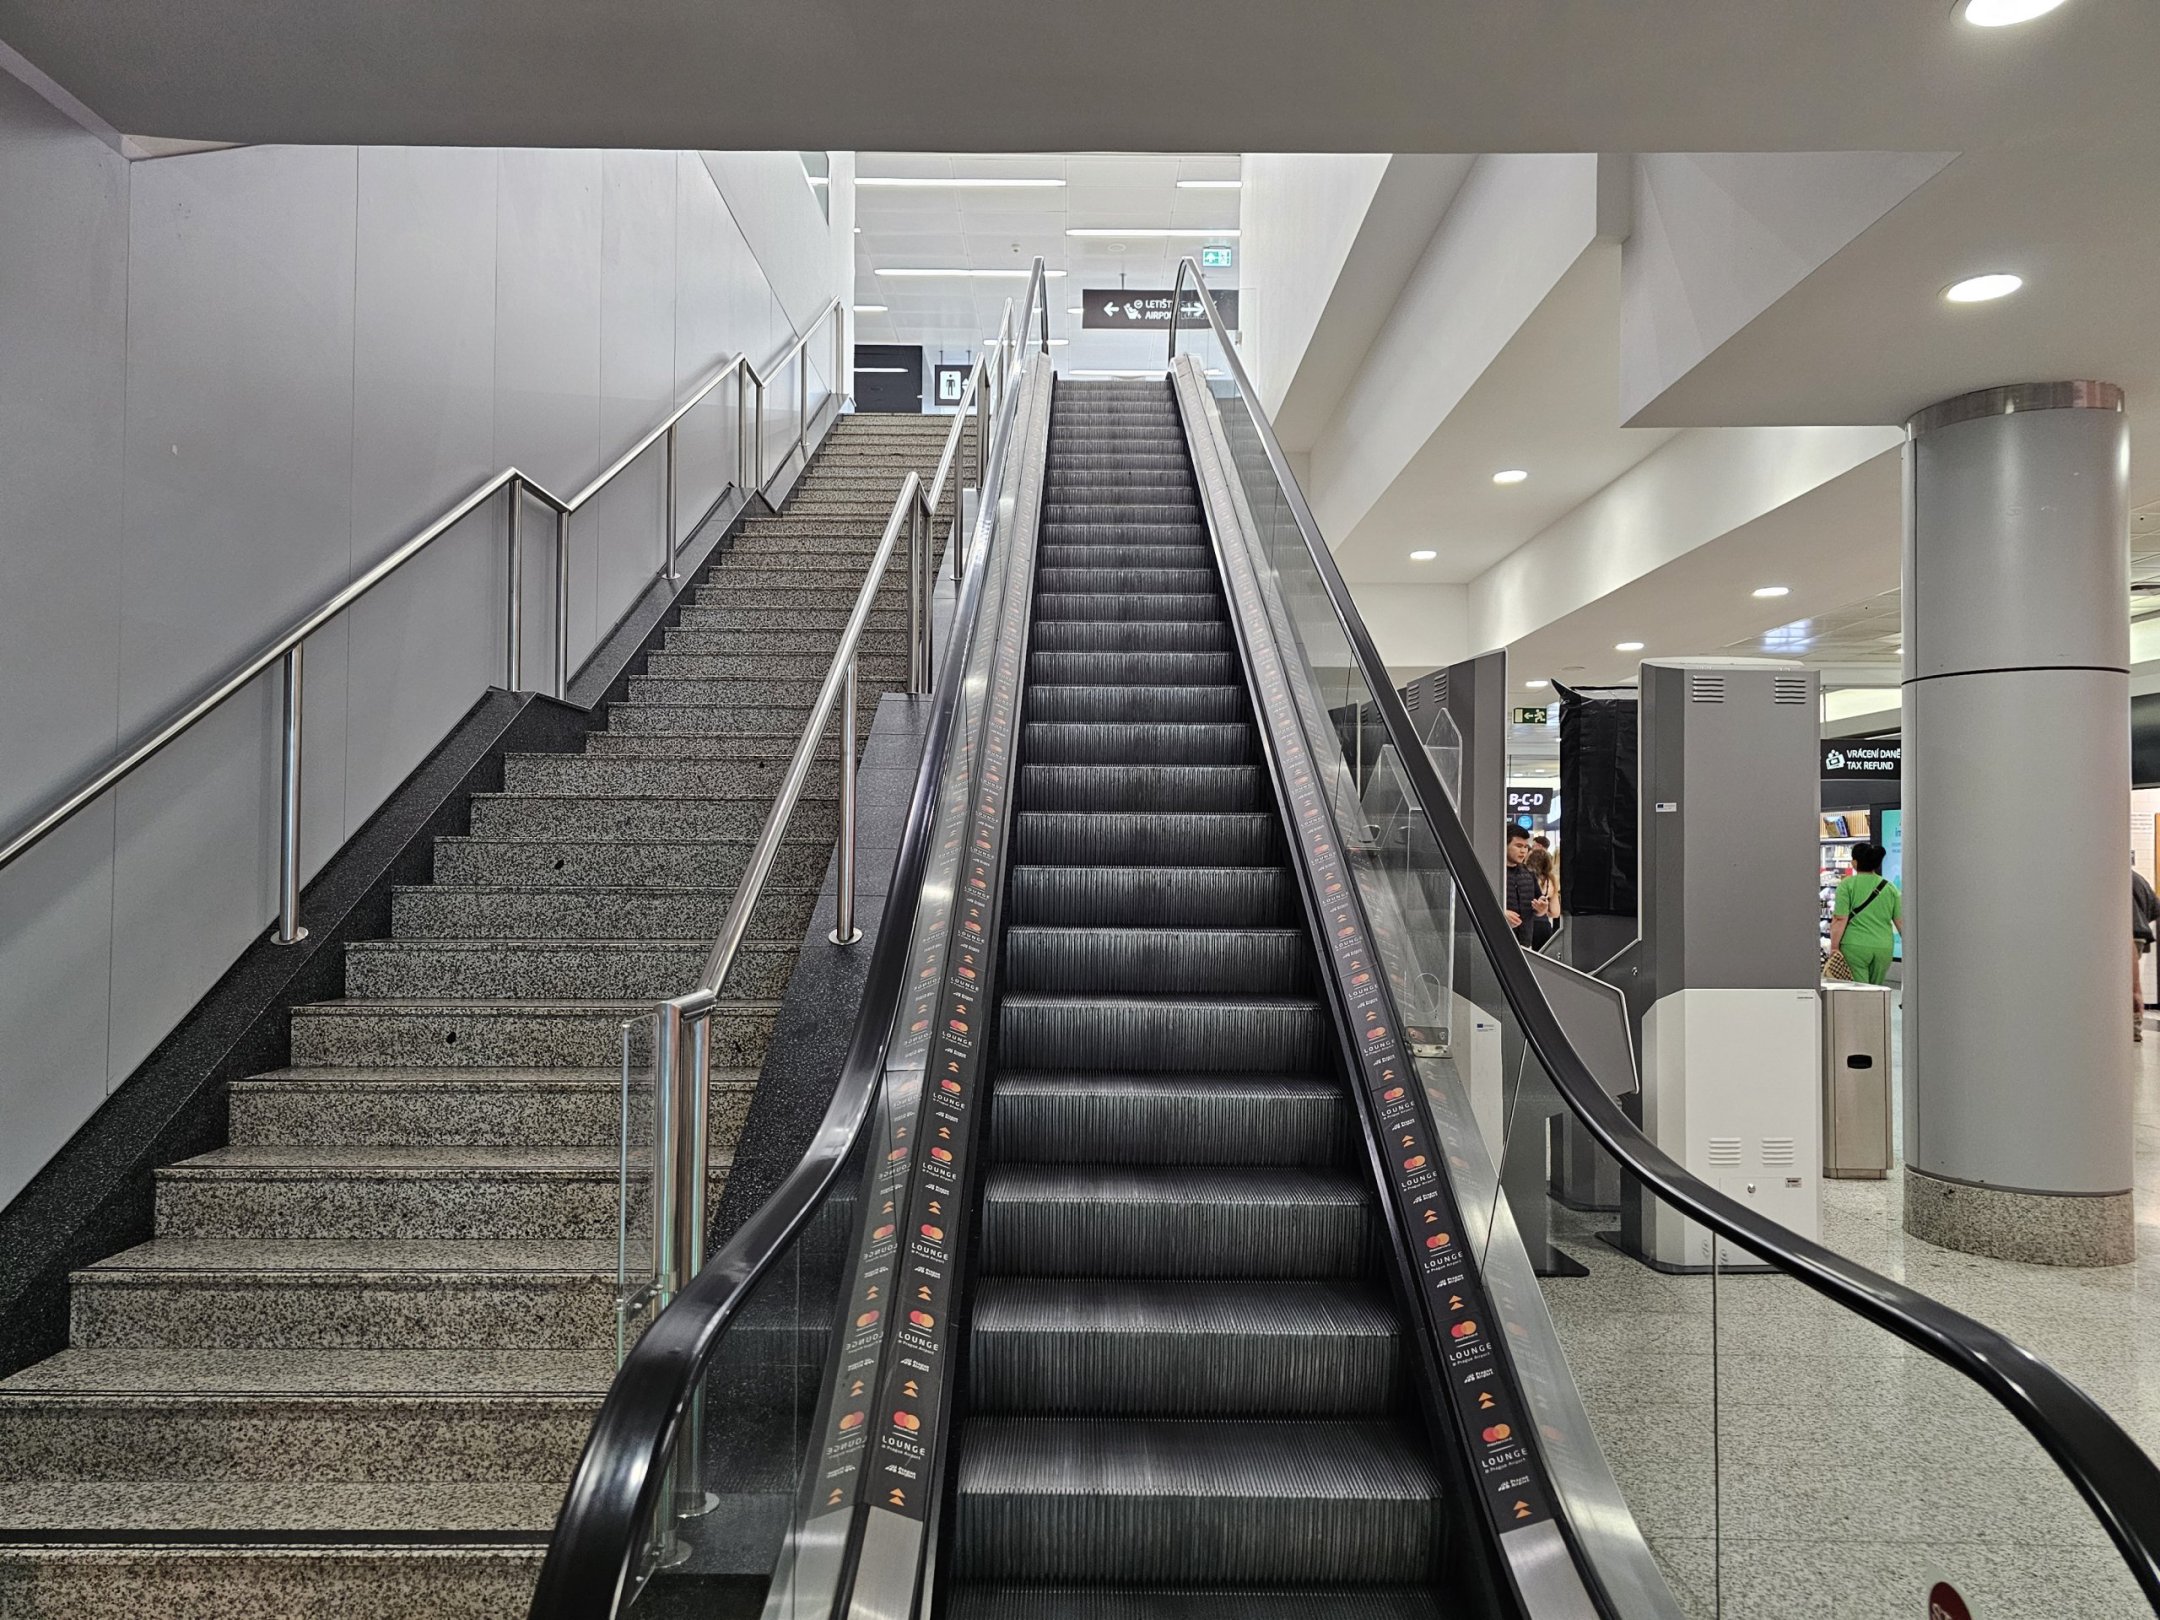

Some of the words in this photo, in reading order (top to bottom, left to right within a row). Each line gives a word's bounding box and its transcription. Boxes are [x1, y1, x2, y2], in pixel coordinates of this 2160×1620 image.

[1145, 299, 1173, 309] LETIŠT
[1846, 748, 1879, 759] VRÁCENÍ
[1846, 761, 1862, 770] TAX
[1864, 761, 1894, 770] REFUND
[1509, 793, 1543, 805] B-C-D
[950, 976, 979, 991] LOUNGE
[942, 1031, 973, 1046] LOUNGE
[1363, 1039, 1395, 1053] LOUNGE
[933, 1092, 965, 1109] LOUNGE
[1381, 1101, 1415, 1116] LOUNGE
[922, 1162, 957, 1180] LOUNGE
[1401, 1171, 1437, 1188] LOUNGE
[911, 1242, 949, 1260] LOUNGE
[1424, 1251, 1463, 1269] LOUNGE
[898, 1331, 939, 1351] LOUNGE
[1449, 1342, 1492, 1361] LOUNGE
[882, 1435, 926, 1456] LOUNGE
[1481, 1447, 1528, 1468] LOUNGE
